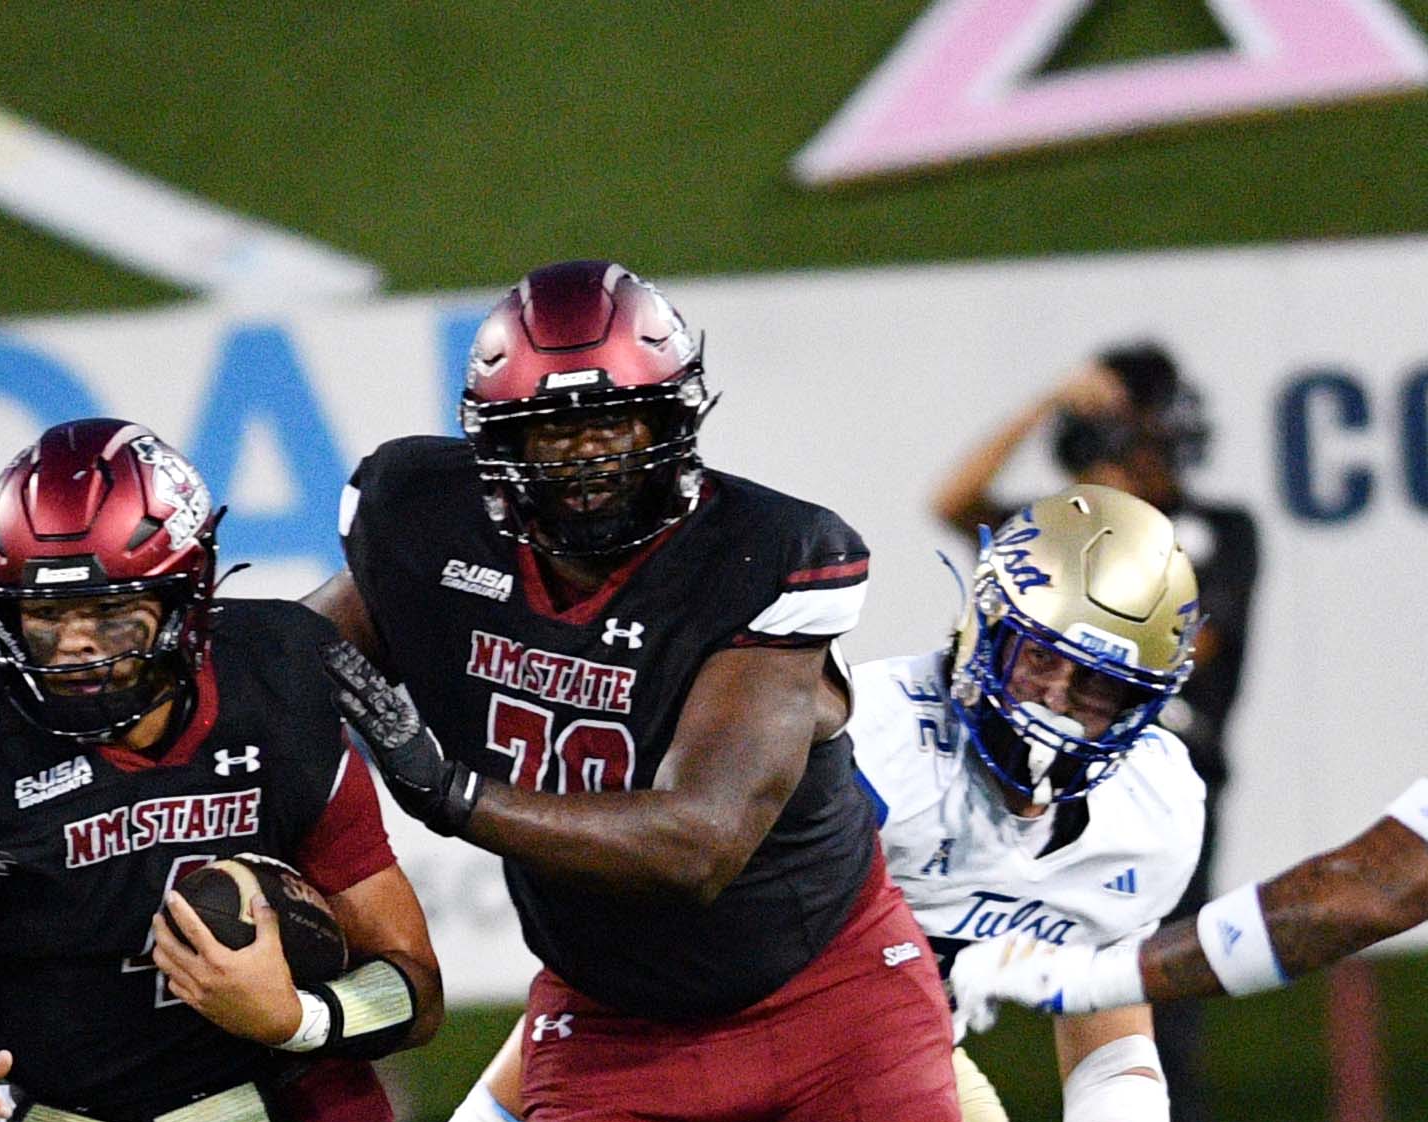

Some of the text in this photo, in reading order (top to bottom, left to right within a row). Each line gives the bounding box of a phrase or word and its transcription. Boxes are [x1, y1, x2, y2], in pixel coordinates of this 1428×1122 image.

[1274, 363, 1428, 530] C
[466, 629, 637, 715] NM STATE
[64, 787, 262, 869] NM STATE
[944, 890, 1078, 946] Tulsa
